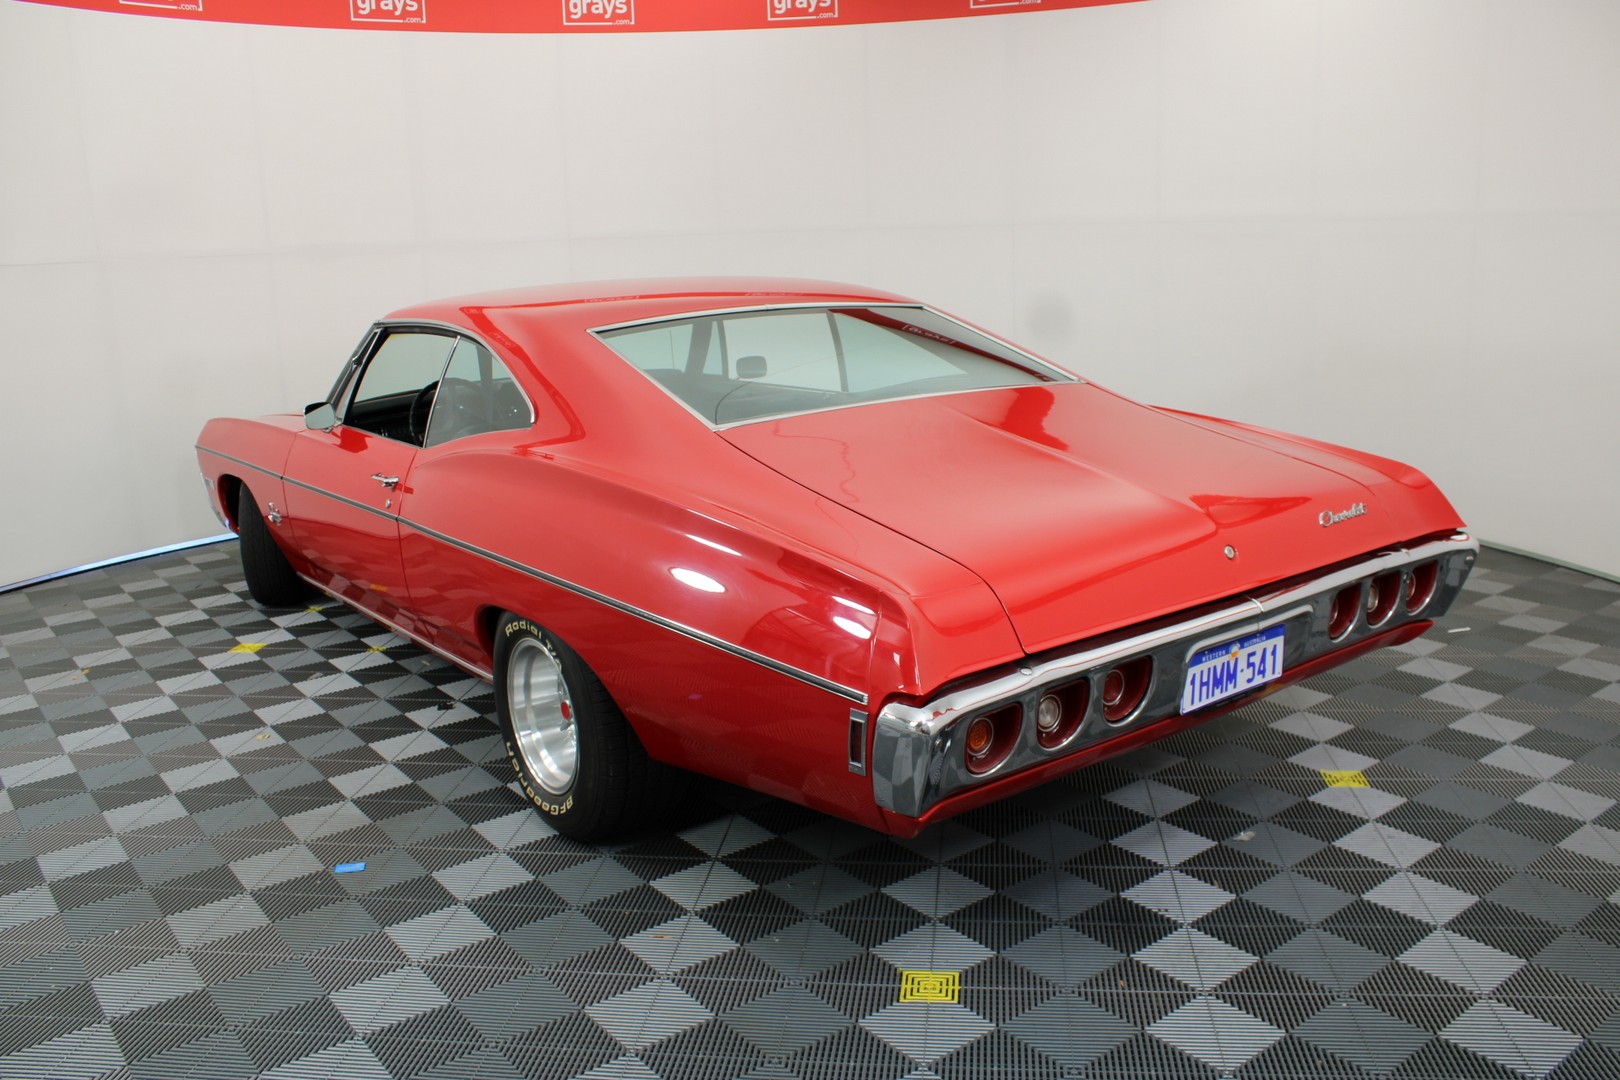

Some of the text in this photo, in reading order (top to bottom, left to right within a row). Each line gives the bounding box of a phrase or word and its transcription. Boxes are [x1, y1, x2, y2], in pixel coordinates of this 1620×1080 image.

[569, 0, 628, 19] grays
[1318, 502, 1367, 527] Chevrolet
[505, 620, 542, 637] Radial
[1202, 635, 1266, 662] WESTERN AUSTRALIA
